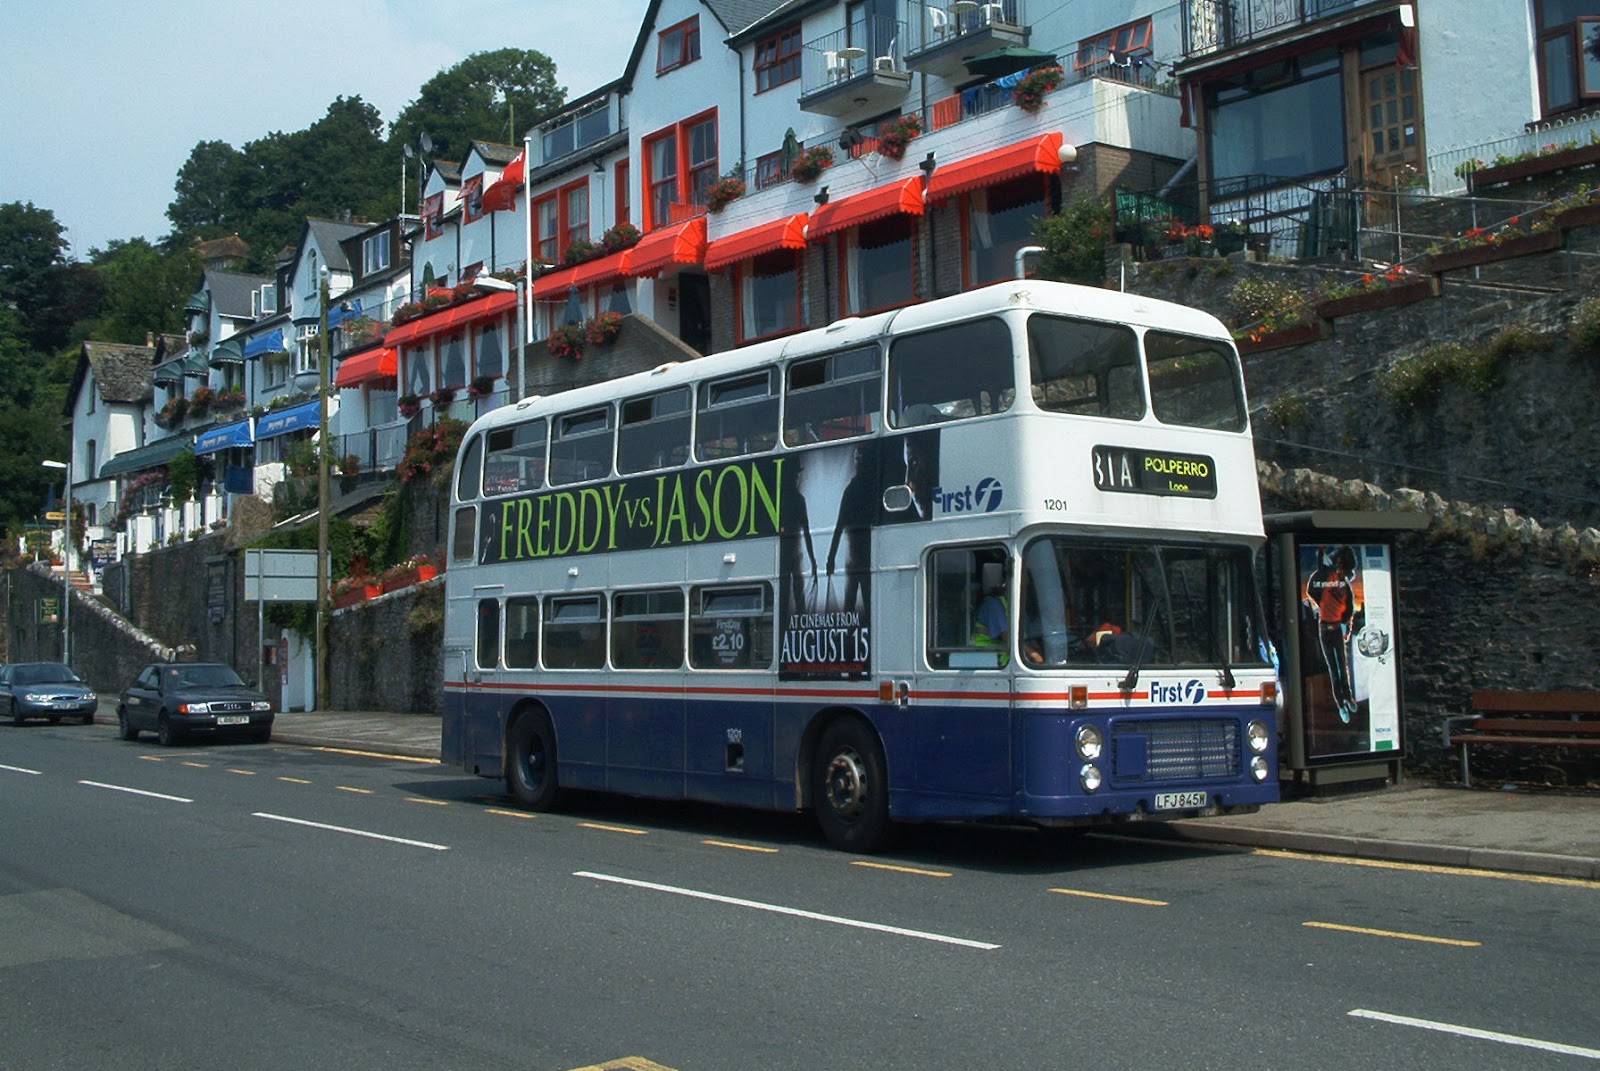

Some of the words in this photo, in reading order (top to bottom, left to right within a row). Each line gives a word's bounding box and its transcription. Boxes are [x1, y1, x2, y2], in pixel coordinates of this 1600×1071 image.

[1145, 457, 1209, 477] POLPERRO
[499, 483, 627, 560] FREDDY
[651, 458, 785, 548] JASON
[932, 485, 972, 513] First
[1044, 499, 1068, 511] 1201
[789, 614, 799, 629] AT
[800, 612, 834, 629] CINEMAS
[836, 611, 860, 627] FROM
[712, 633, 744, 650] £2.10
[780, 628, 848, 663] AUGUST
[852, 627, 869, 662] 15
[1151, 681, 1183, 703] First
